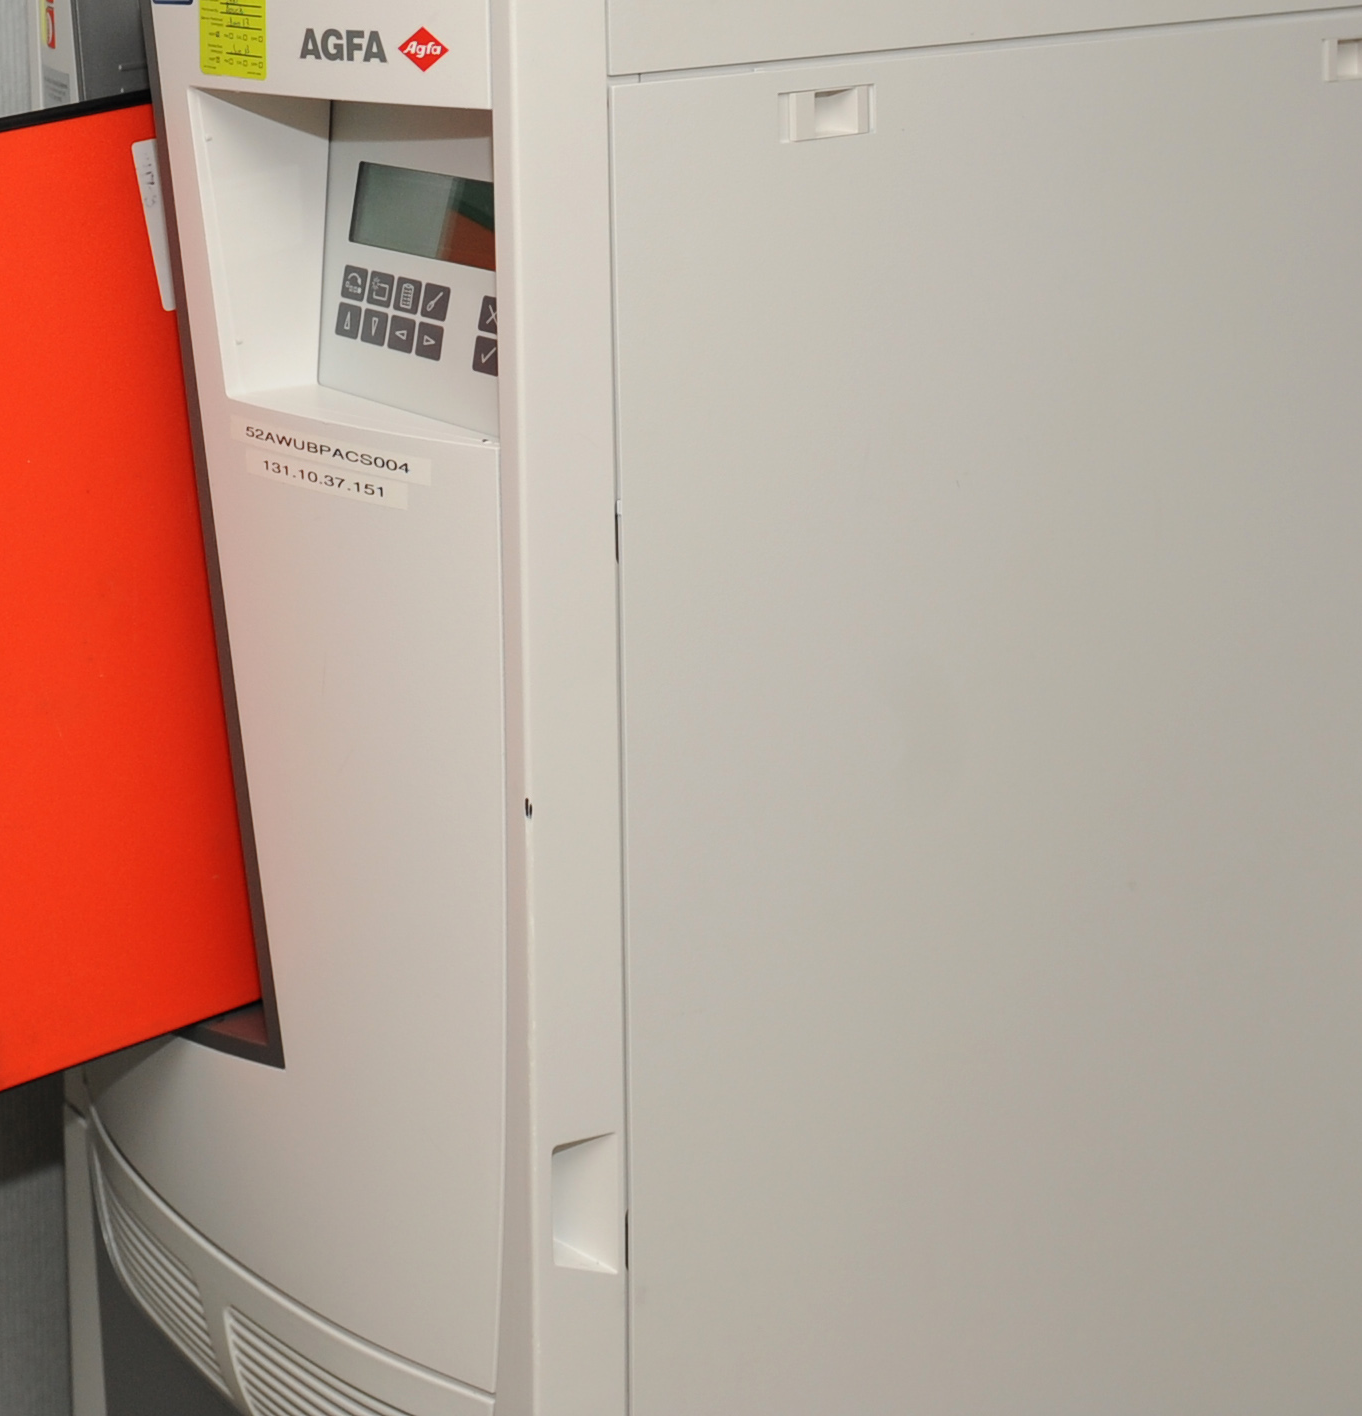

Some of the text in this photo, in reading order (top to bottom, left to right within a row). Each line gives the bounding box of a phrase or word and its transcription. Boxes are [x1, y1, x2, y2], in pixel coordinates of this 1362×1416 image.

[300, 28, 387, 63] AGFA
[403, 41, 442, 58] Agfa
[245, 426, 410, 474] 52AWUBPACS004
[263, 460, 385, 498] 131.10.37.151
